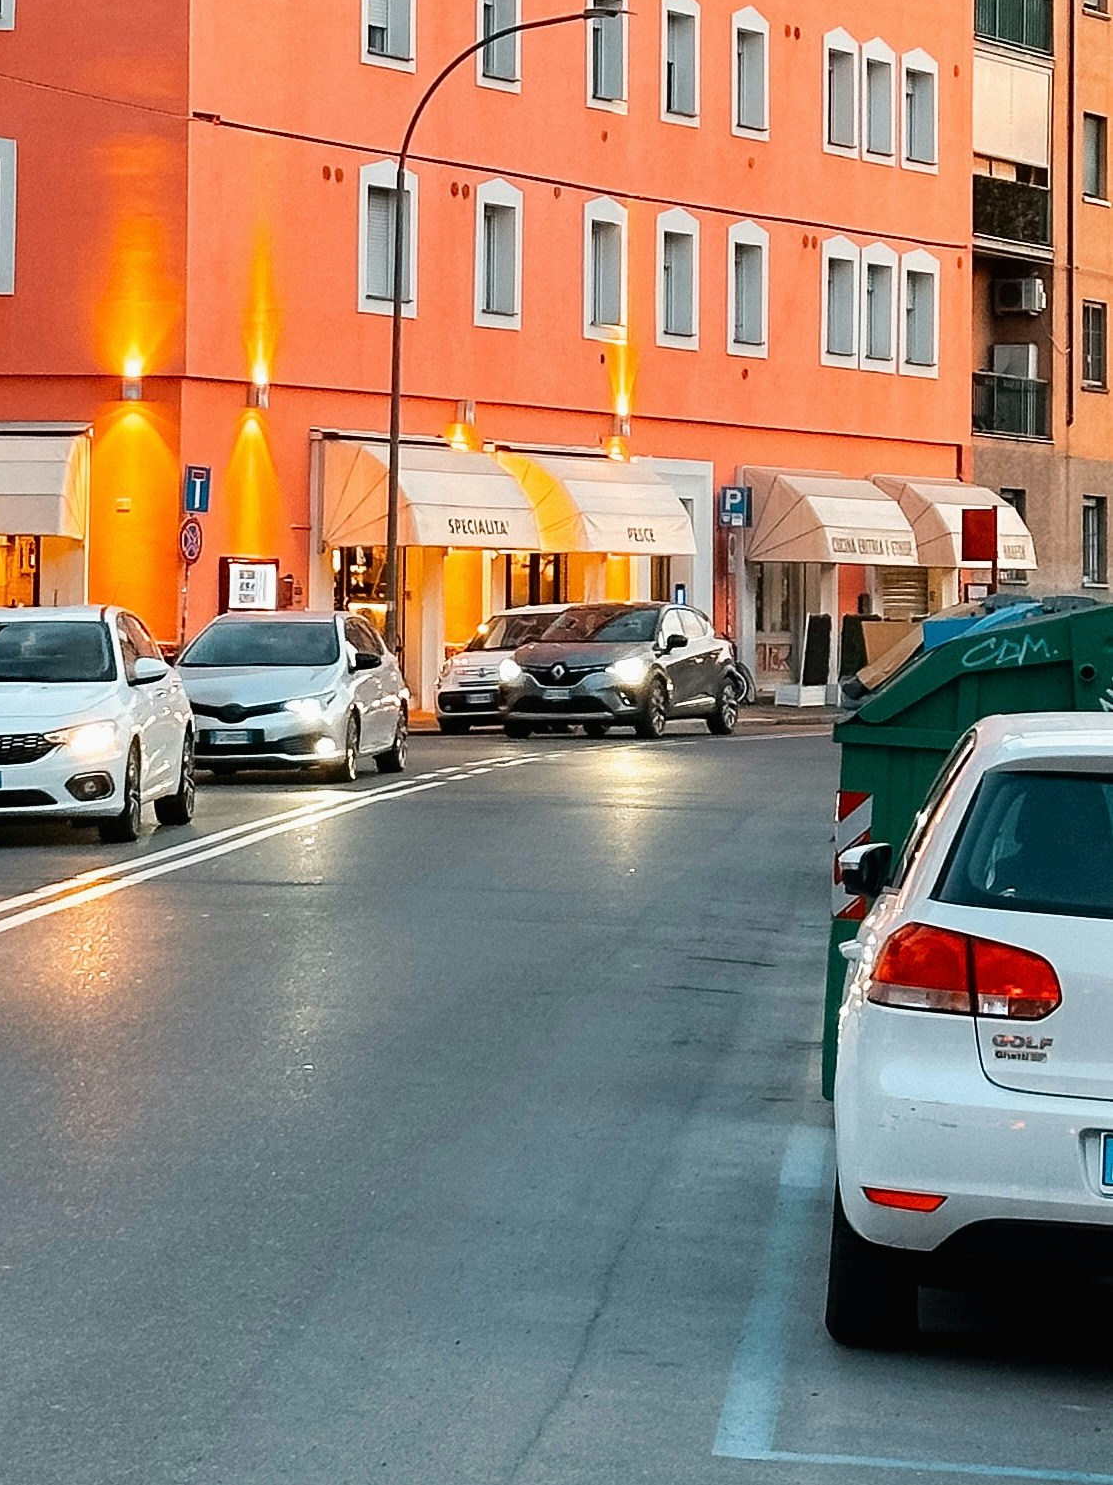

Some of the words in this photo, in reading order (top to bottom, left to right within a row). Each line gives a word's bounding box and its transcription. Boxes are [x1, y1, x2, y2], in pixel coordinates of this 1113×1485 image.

[725, 489, 742, 511] P
[627, 527, 656, 542] PESCE
[992, 1034, 1054, 1050] GOLF
